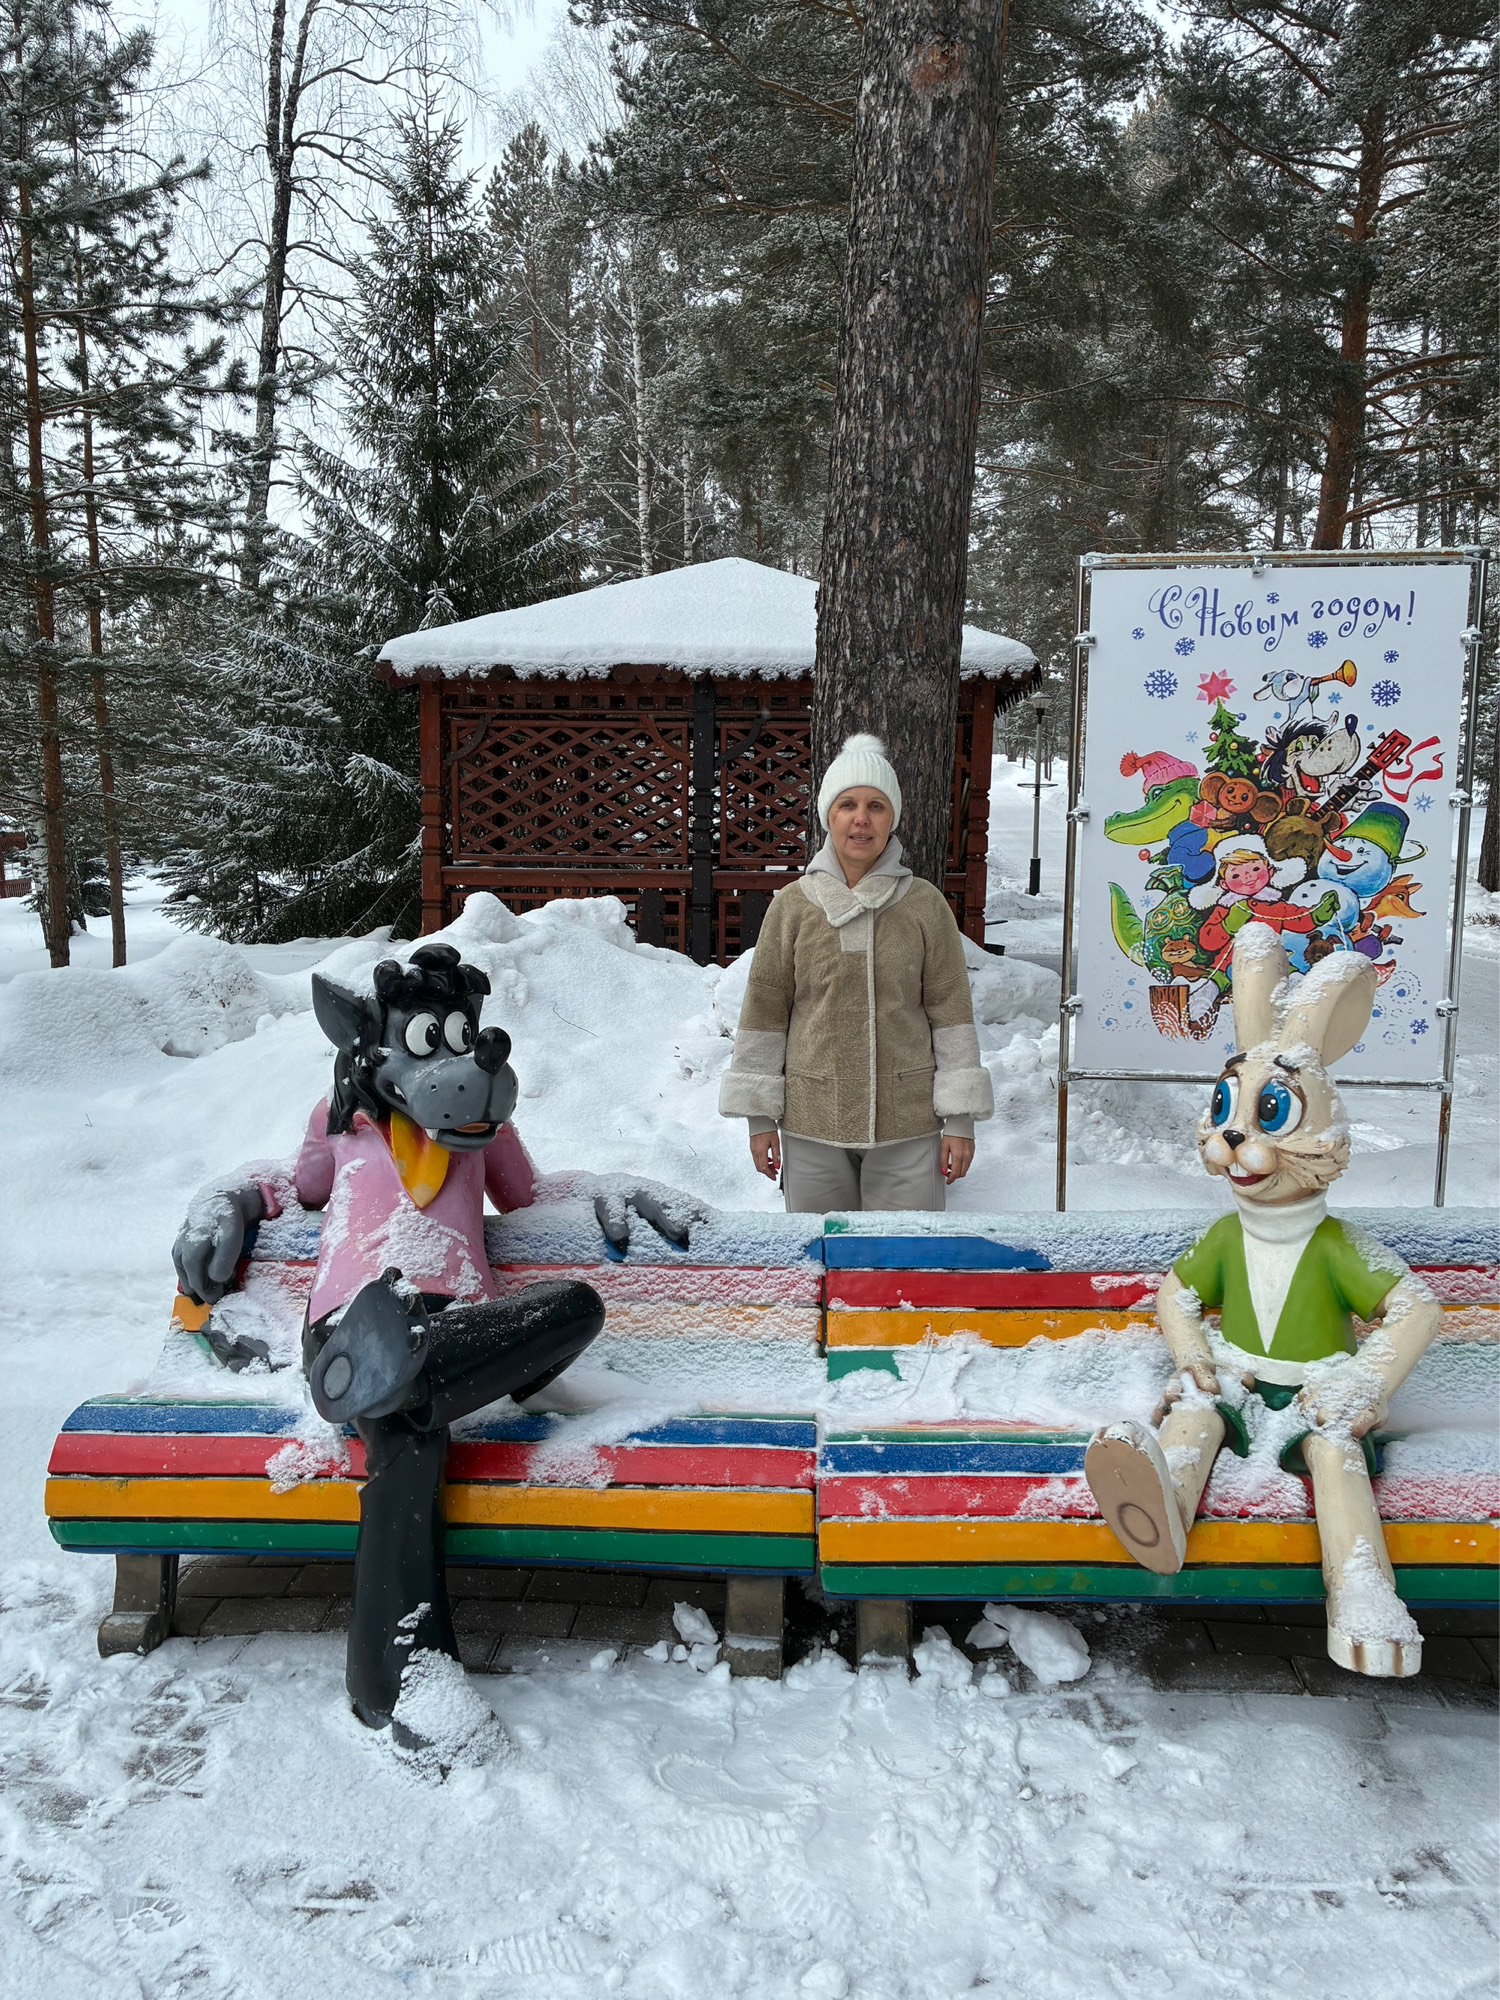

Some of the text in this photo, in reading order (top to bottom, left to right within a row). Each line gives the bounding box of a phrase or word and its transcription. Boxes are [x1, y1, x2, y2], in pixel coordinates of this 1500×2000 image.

[1148, 584, 1415, 652] С Новым годом!
